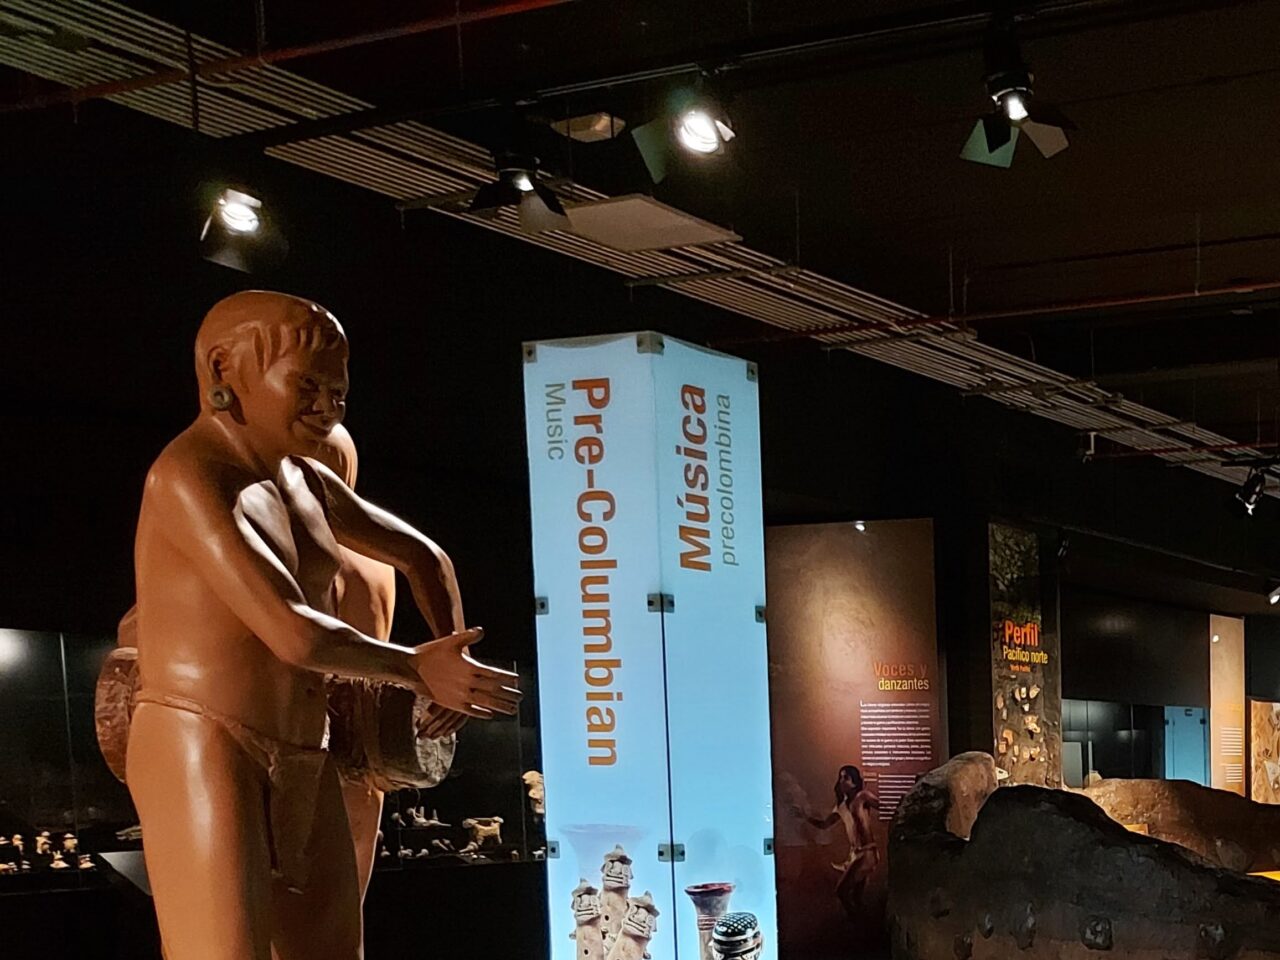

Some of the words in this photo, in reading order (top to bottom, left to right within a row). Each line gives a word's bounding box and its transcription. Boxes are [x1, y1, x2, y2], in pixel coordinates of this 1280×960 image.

[545, 383, 566, 461] Music
[676, 383, 712, 572] Música
[714, 393, 739, 567] precolombina
[571, 376, 624, 767] Pre-Columbian
[1004, 620, 1039, 647] Perfil
[1030, 650, 1048, 664] norte
[873, 662, 914, 677] Voces
[920, 665, 928, 678] y
[878, 677, 929, 691] danzantes
